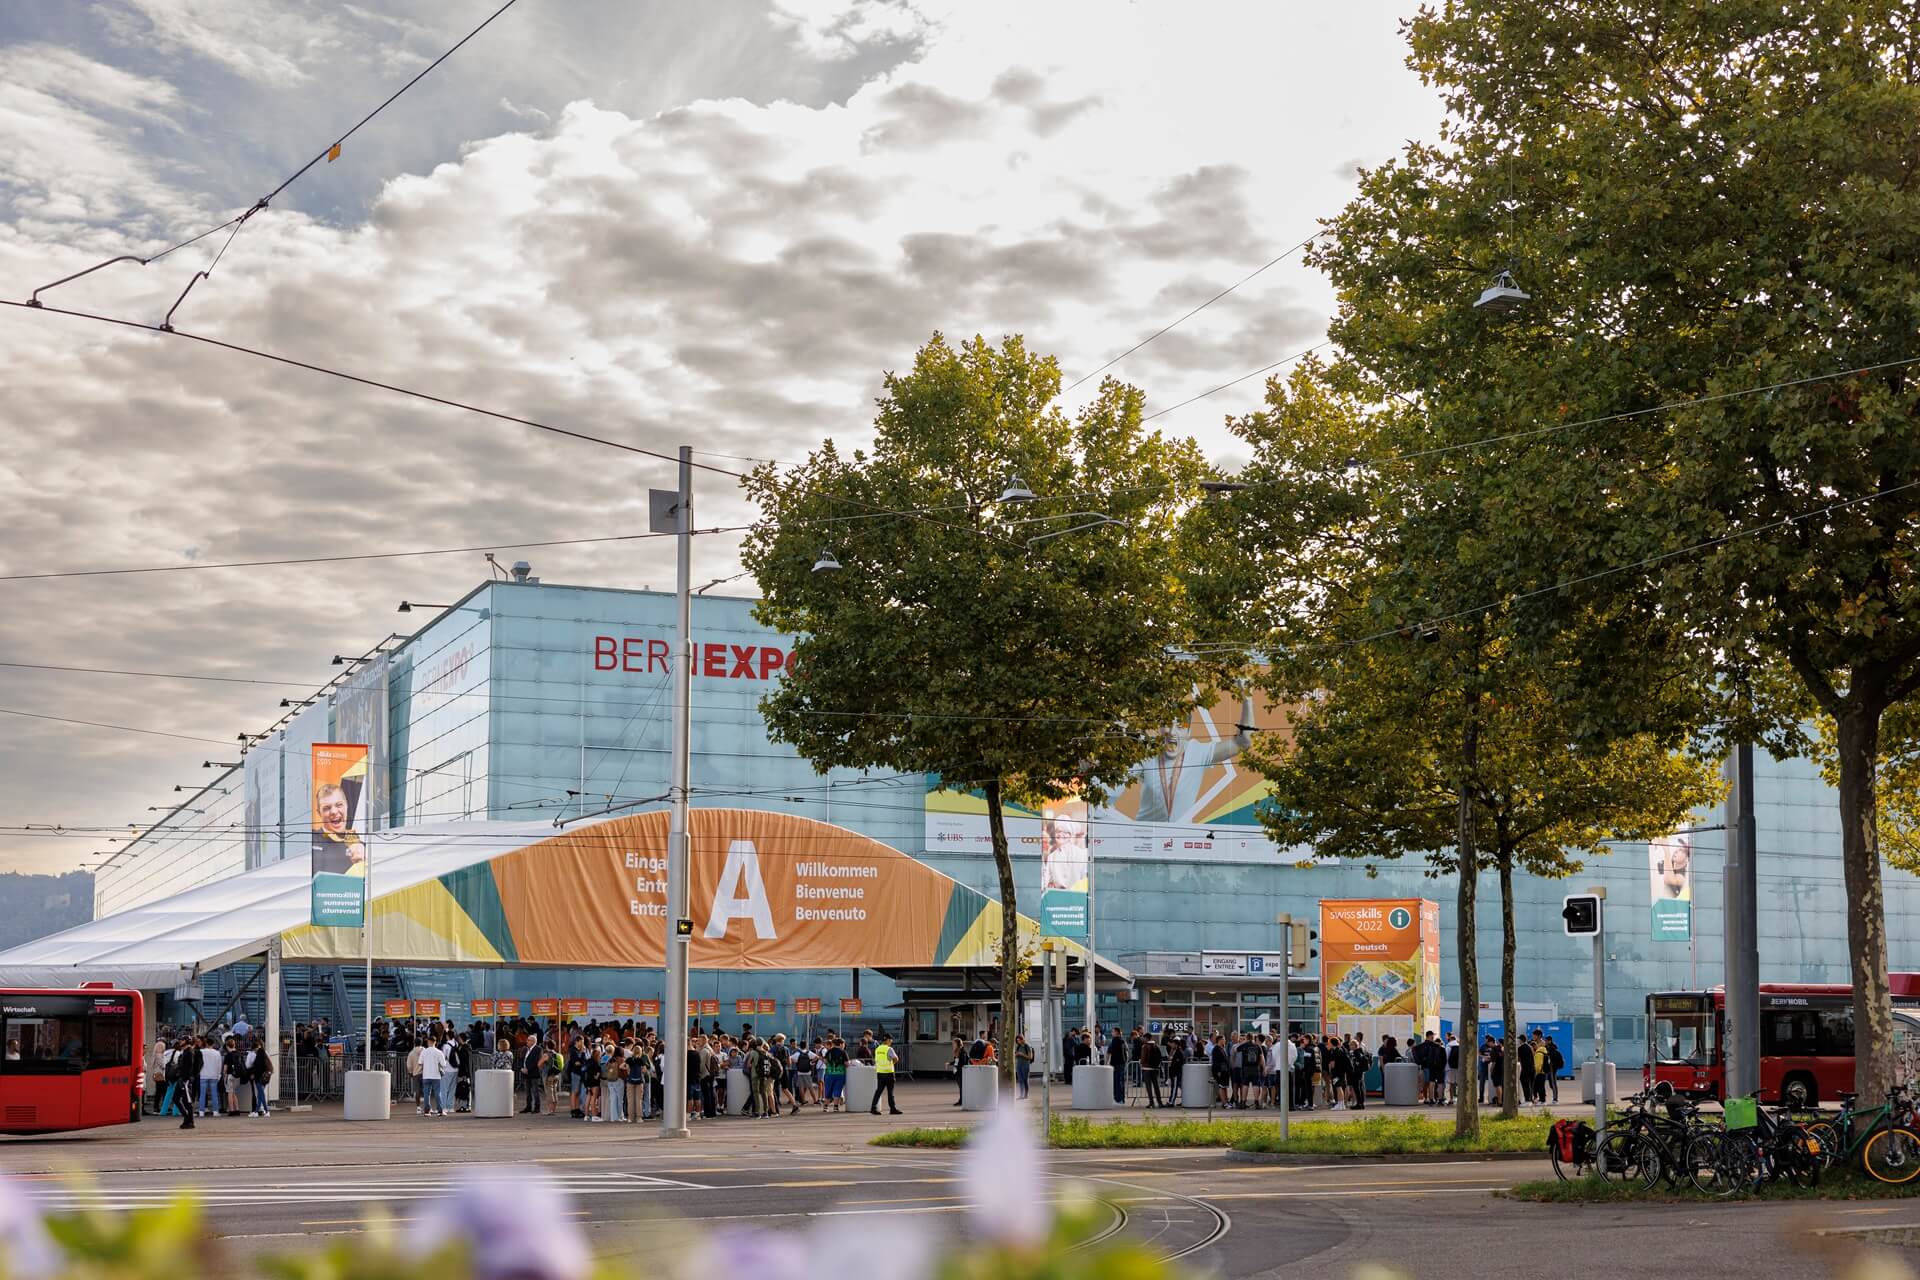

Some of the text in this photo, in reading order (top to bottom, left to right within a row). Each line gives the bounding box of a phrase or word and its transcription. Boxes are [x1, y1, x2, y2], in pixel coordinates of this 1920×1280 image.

[594, 635, 800, 681] BEREXP
[946, 833, 964, 842] UBS
[796, 862, 878, 878] Willkommen
[703, 839, 777, 939] A
[796, 883, 865, 899] Bienvenue
[796, 906, 867, 921] Benvenuto
[1357, 921, 1383, 932] 2022
[1161, 1022, 1188, 1031] KASSE
